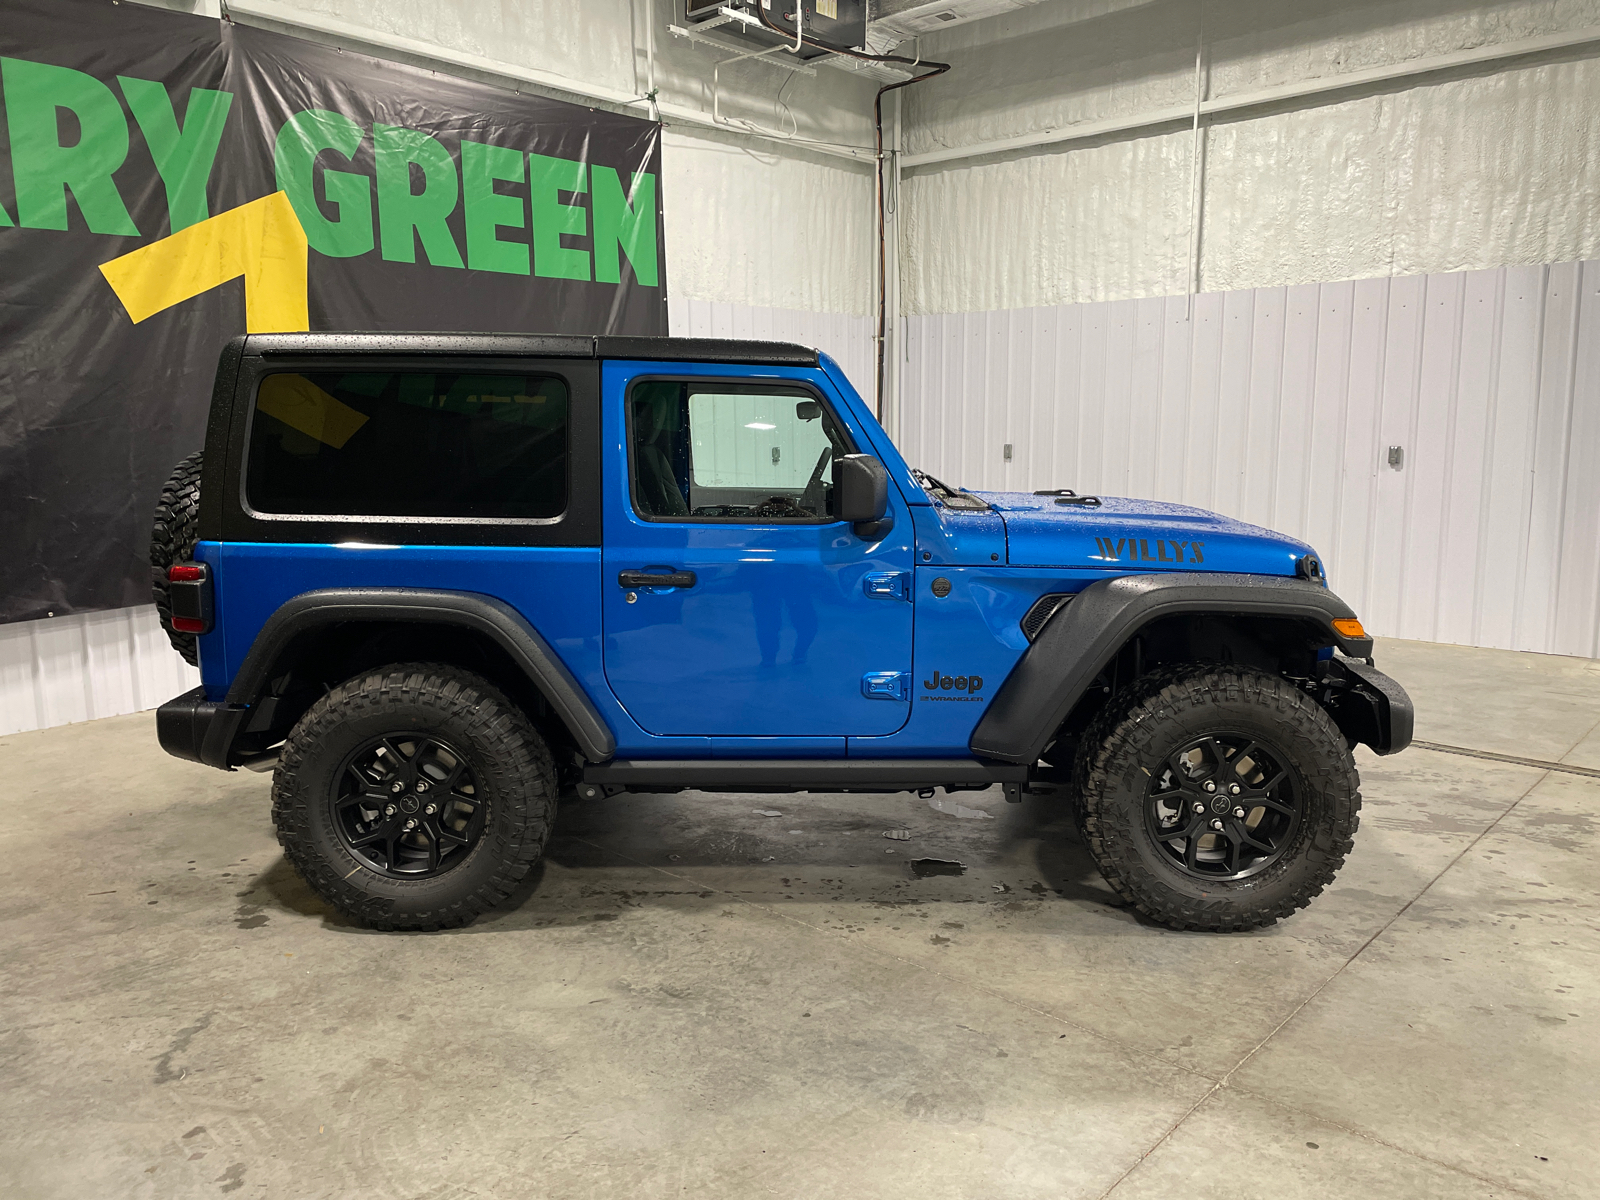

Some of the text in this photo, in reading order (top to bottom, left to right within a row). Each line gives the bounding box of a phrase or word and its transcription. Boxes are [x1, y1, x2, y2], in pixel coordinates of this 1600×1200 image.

[0, 57, 658, 287] RY GREEN
[1094, 537, 1205, 564] WILLYS
[923, 670, 984, 694] Jeep
